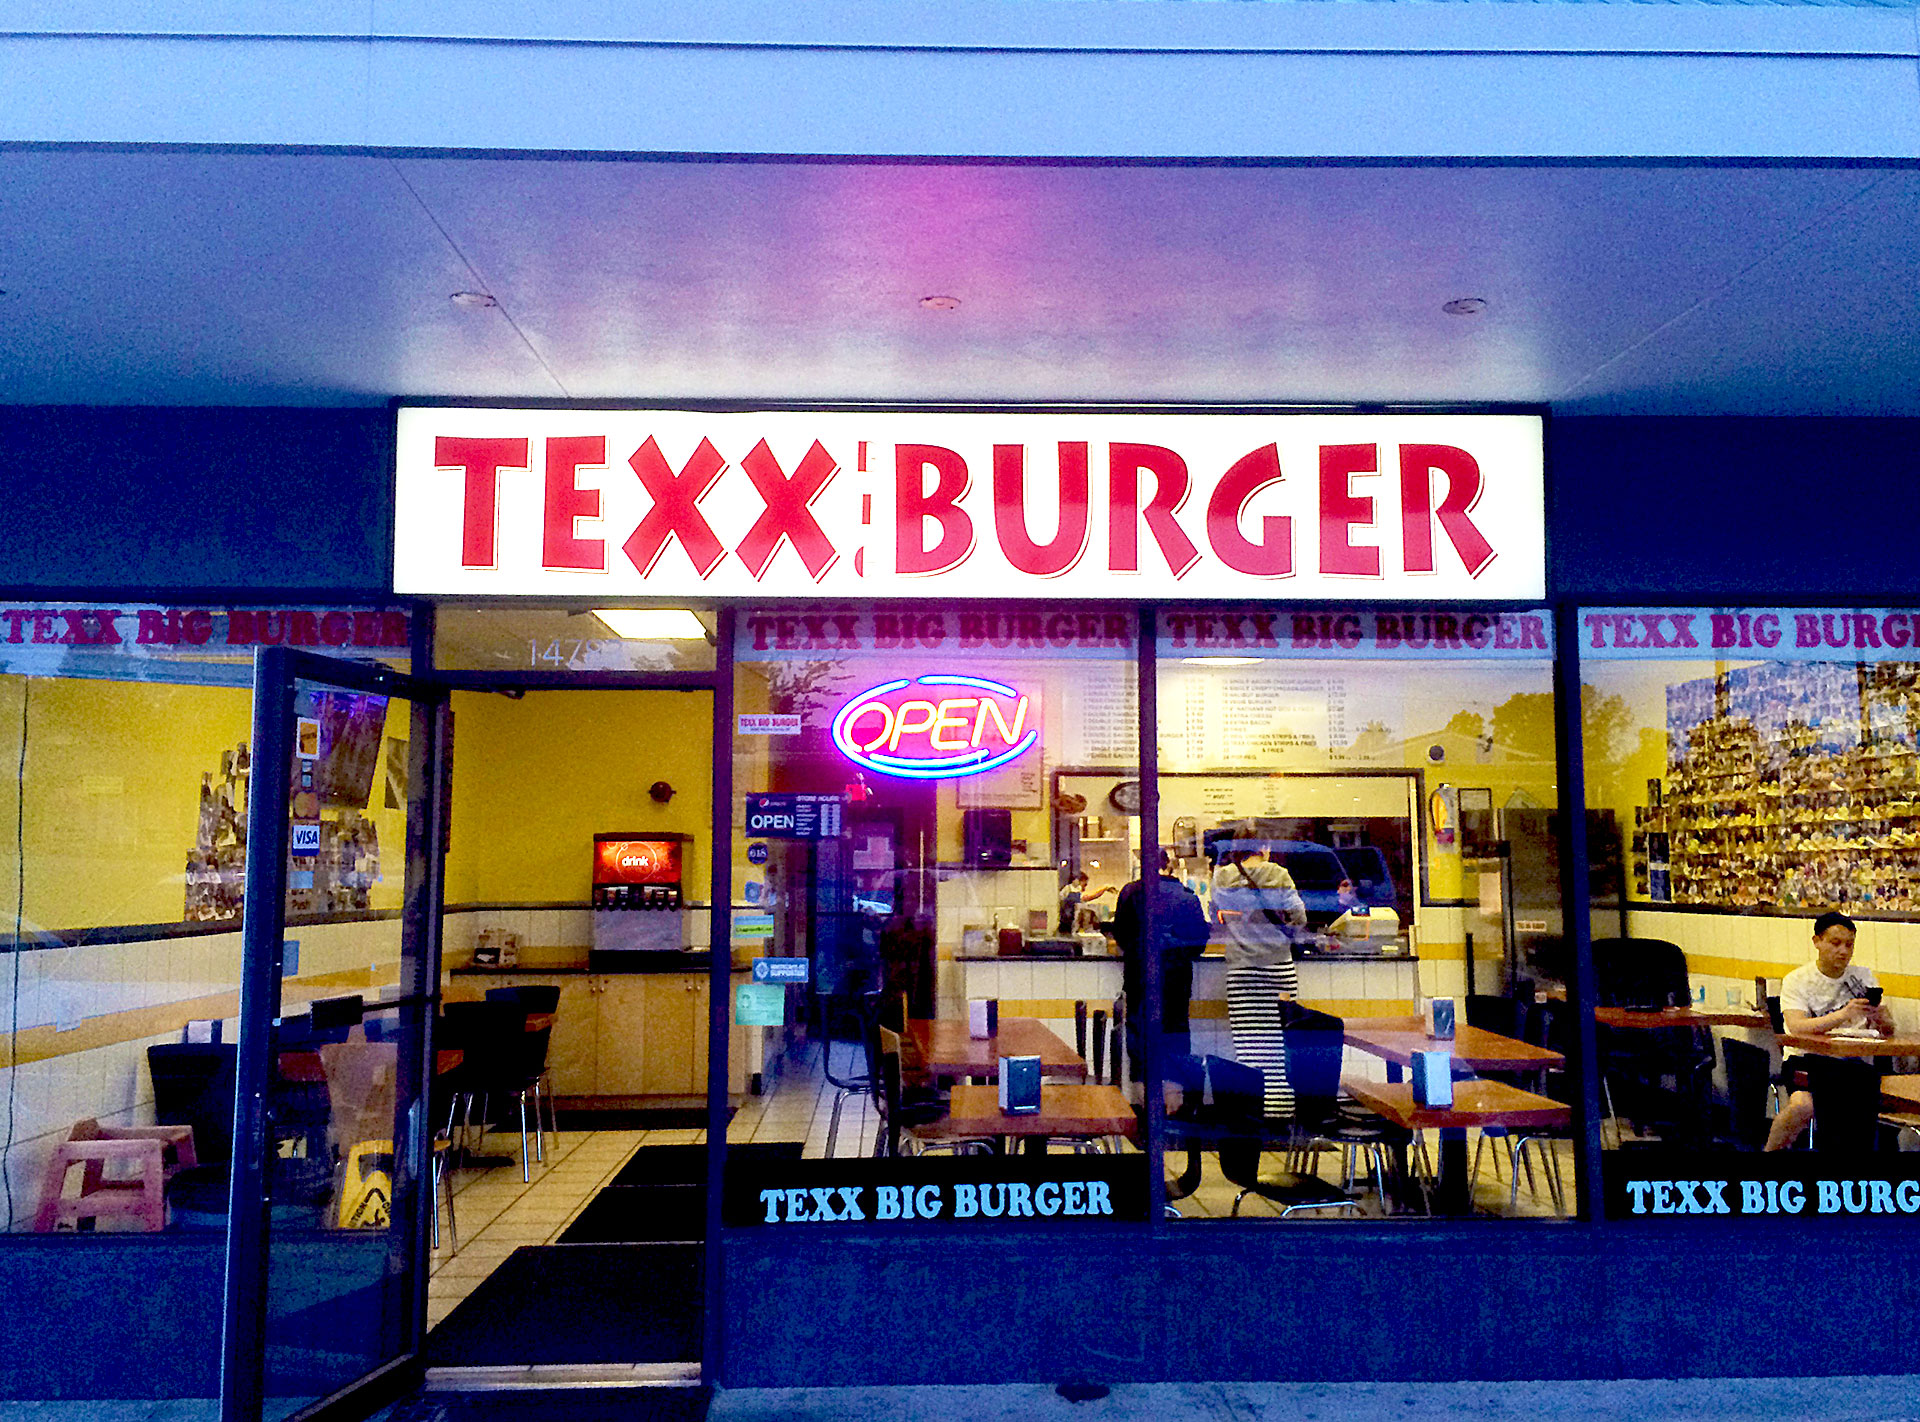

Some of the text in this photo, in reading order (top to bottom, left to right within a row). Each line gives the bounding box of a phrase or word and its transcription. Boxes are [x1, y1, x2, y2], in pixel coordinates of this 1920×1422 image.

[434, 434, 841, 583] TEXX
[894, 440, 1498, 580] BURGER
[2, 609, 410, 647] TEXX BIG BURGER
[747, 613, 1131, 651] TEXX BIG BURGER
[1166, 613, 1549, 650] TEXX BIG BURGER
[1584, 613, 1920, 649] TEXX BIG BURG
[843, 695, 1029, 753] OPEN
[295, 829, 319, 845] VISA
[750, 814, 795, 829] OPEN
[621, 855, 649, 867] drink
[760, 1181, 1114, 1223] TEXX BIG BURGER
[1626, 1180, 1920, 1214] TEXX BIG BURG
